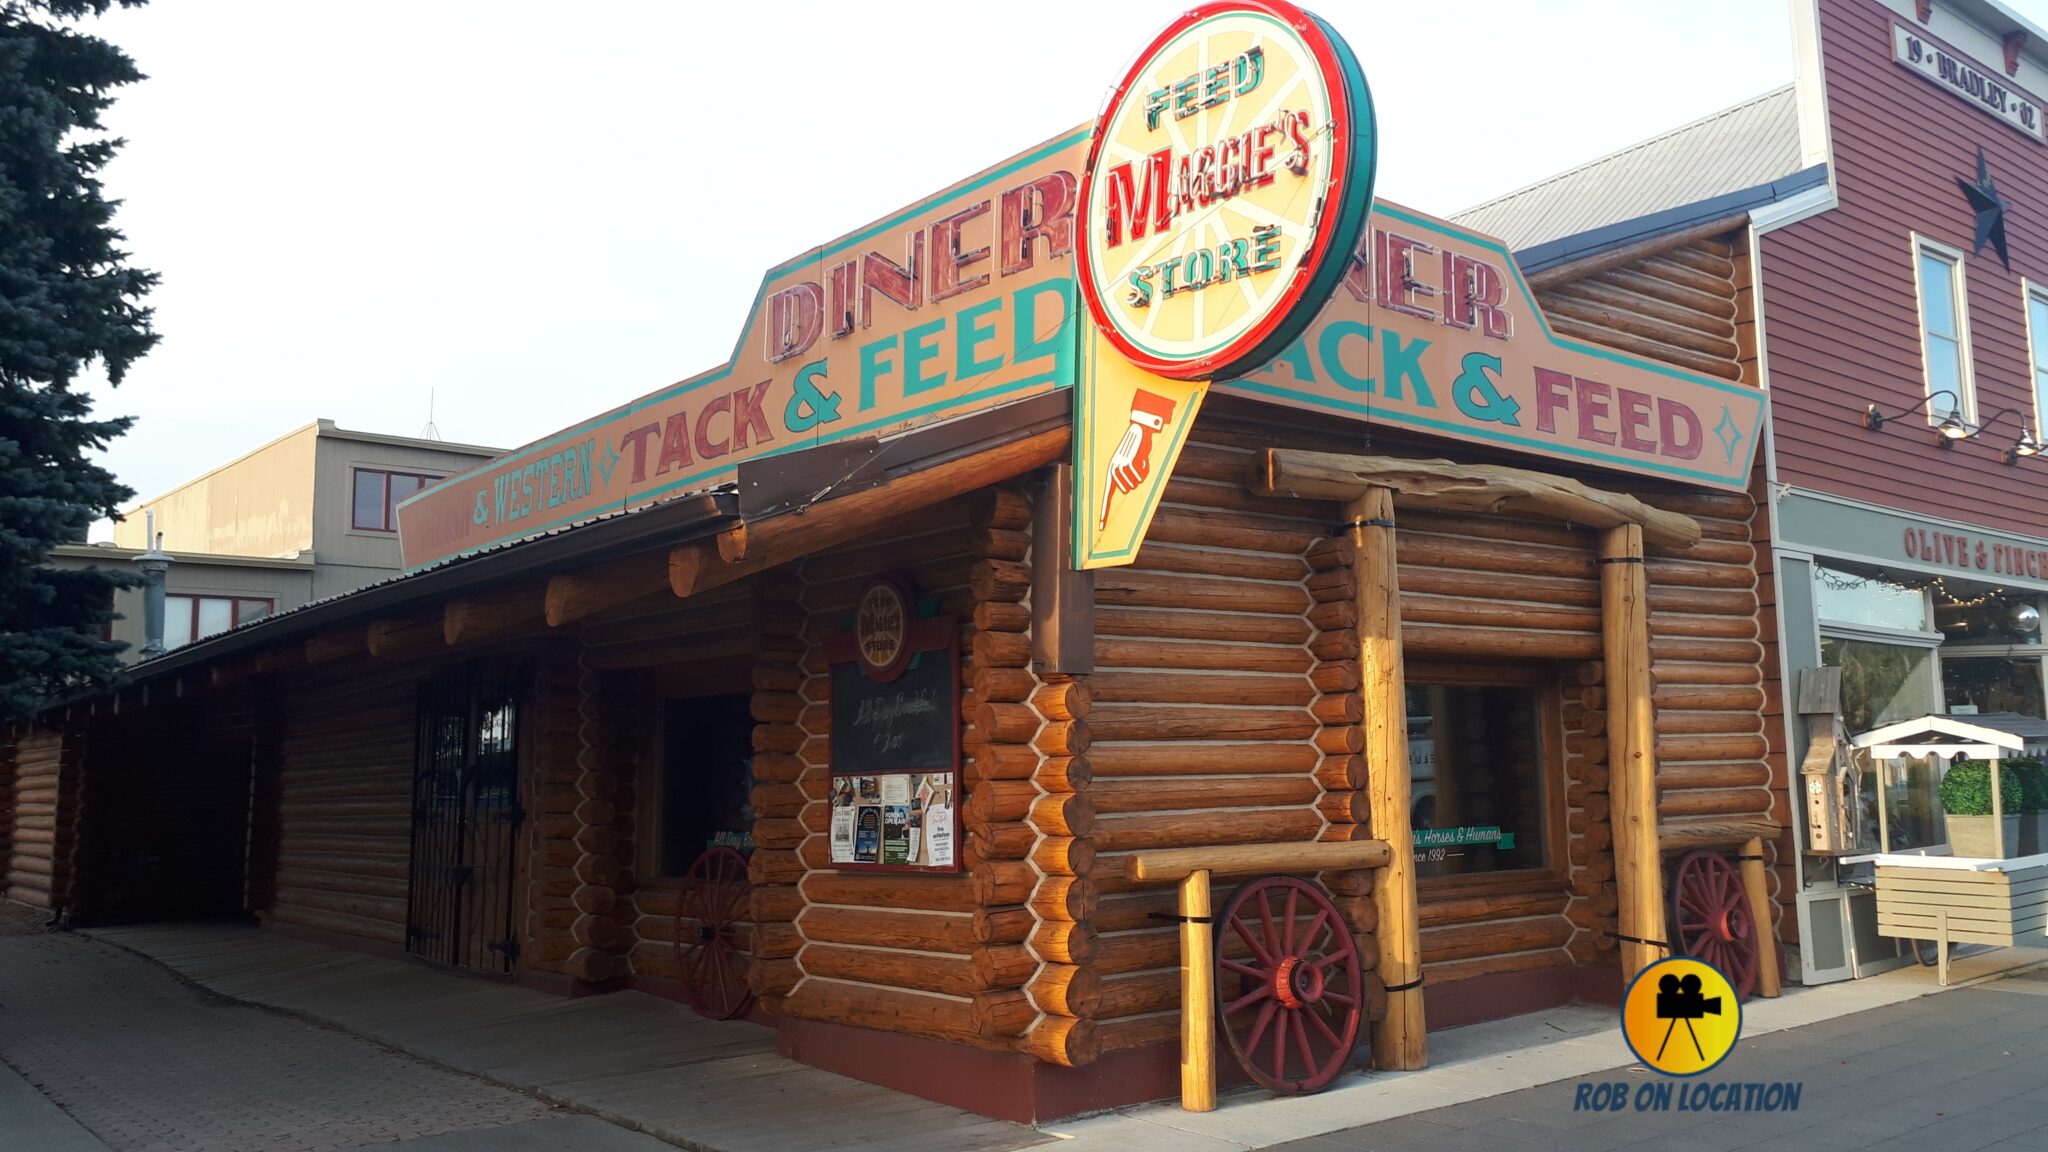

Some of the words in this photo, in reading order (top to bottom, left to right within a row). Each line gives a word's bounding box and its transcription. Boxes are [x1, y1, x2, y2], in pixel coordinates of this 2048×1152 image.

[1143, 45, 1265, 131] FEED
[1906, 36, 1923, 64] 19
[1936, 52, 2007, 113] BRADLEY
[2020, 102, 2036, 130] 02
[1104, 108, 1312, 249] MAGGIE'S
[764, 170, 1078, 364] DINER
[1126, 225, 1282, 308] STORE
[620, 378, 774, 484] TACK
[784, 356, 842, 433] &
[857, 277, 1073, 413] FEED
[1264, 320, 1440, 409] ACK
[1452, 352, 1521, 427] &
[1533, 366, 1703, 460] FEED
[473, 488, 490, 526] &
[493, 438, 594, 526] WESTERN
[1904, 527, 1970, 567] OLIVE
[1975, 540, 1989, 569] &
[865, 639, 896, 651] STORE
[713, 830, 727, 846] All
[727, 830, 740, 850] Day
[1413, 853, 1426, 862] nce
[1428, 848, 1446, 862] 1992
[1424, 828, 1455, 844] Horses
[1457, 826, 1465, 842] &
[1466, 825, 1502, 841] Humans
